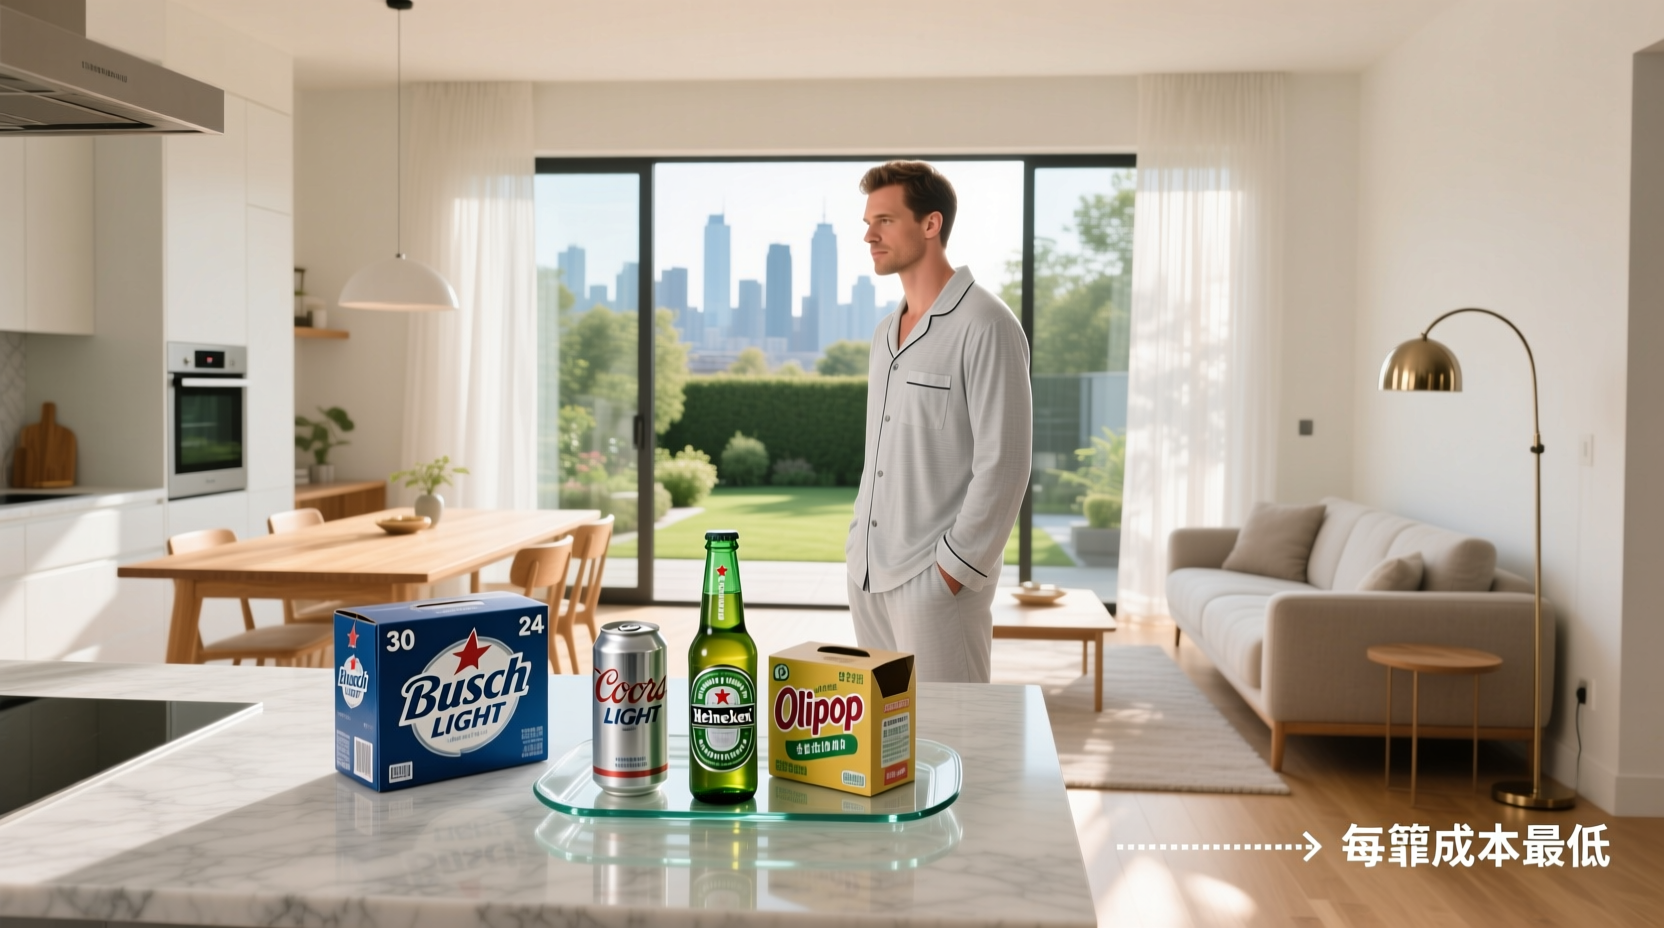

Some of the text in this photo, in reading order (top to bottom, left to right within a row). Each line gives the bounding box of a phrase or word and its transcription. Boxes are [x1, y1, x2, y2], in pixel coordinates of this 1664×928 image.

[518, 614, 545, 636] 24
[386, 629, 415, 652] 30
[402, 654, 530, 723] Busch
[594, 666, 668, 704] Coors
[431, 702, 506, 739] LIGHT
[603, 704, 662, 726] LIGHT
[693, 708, 753, 724] Heineken
[774, 686, 863, 736] Olipop
